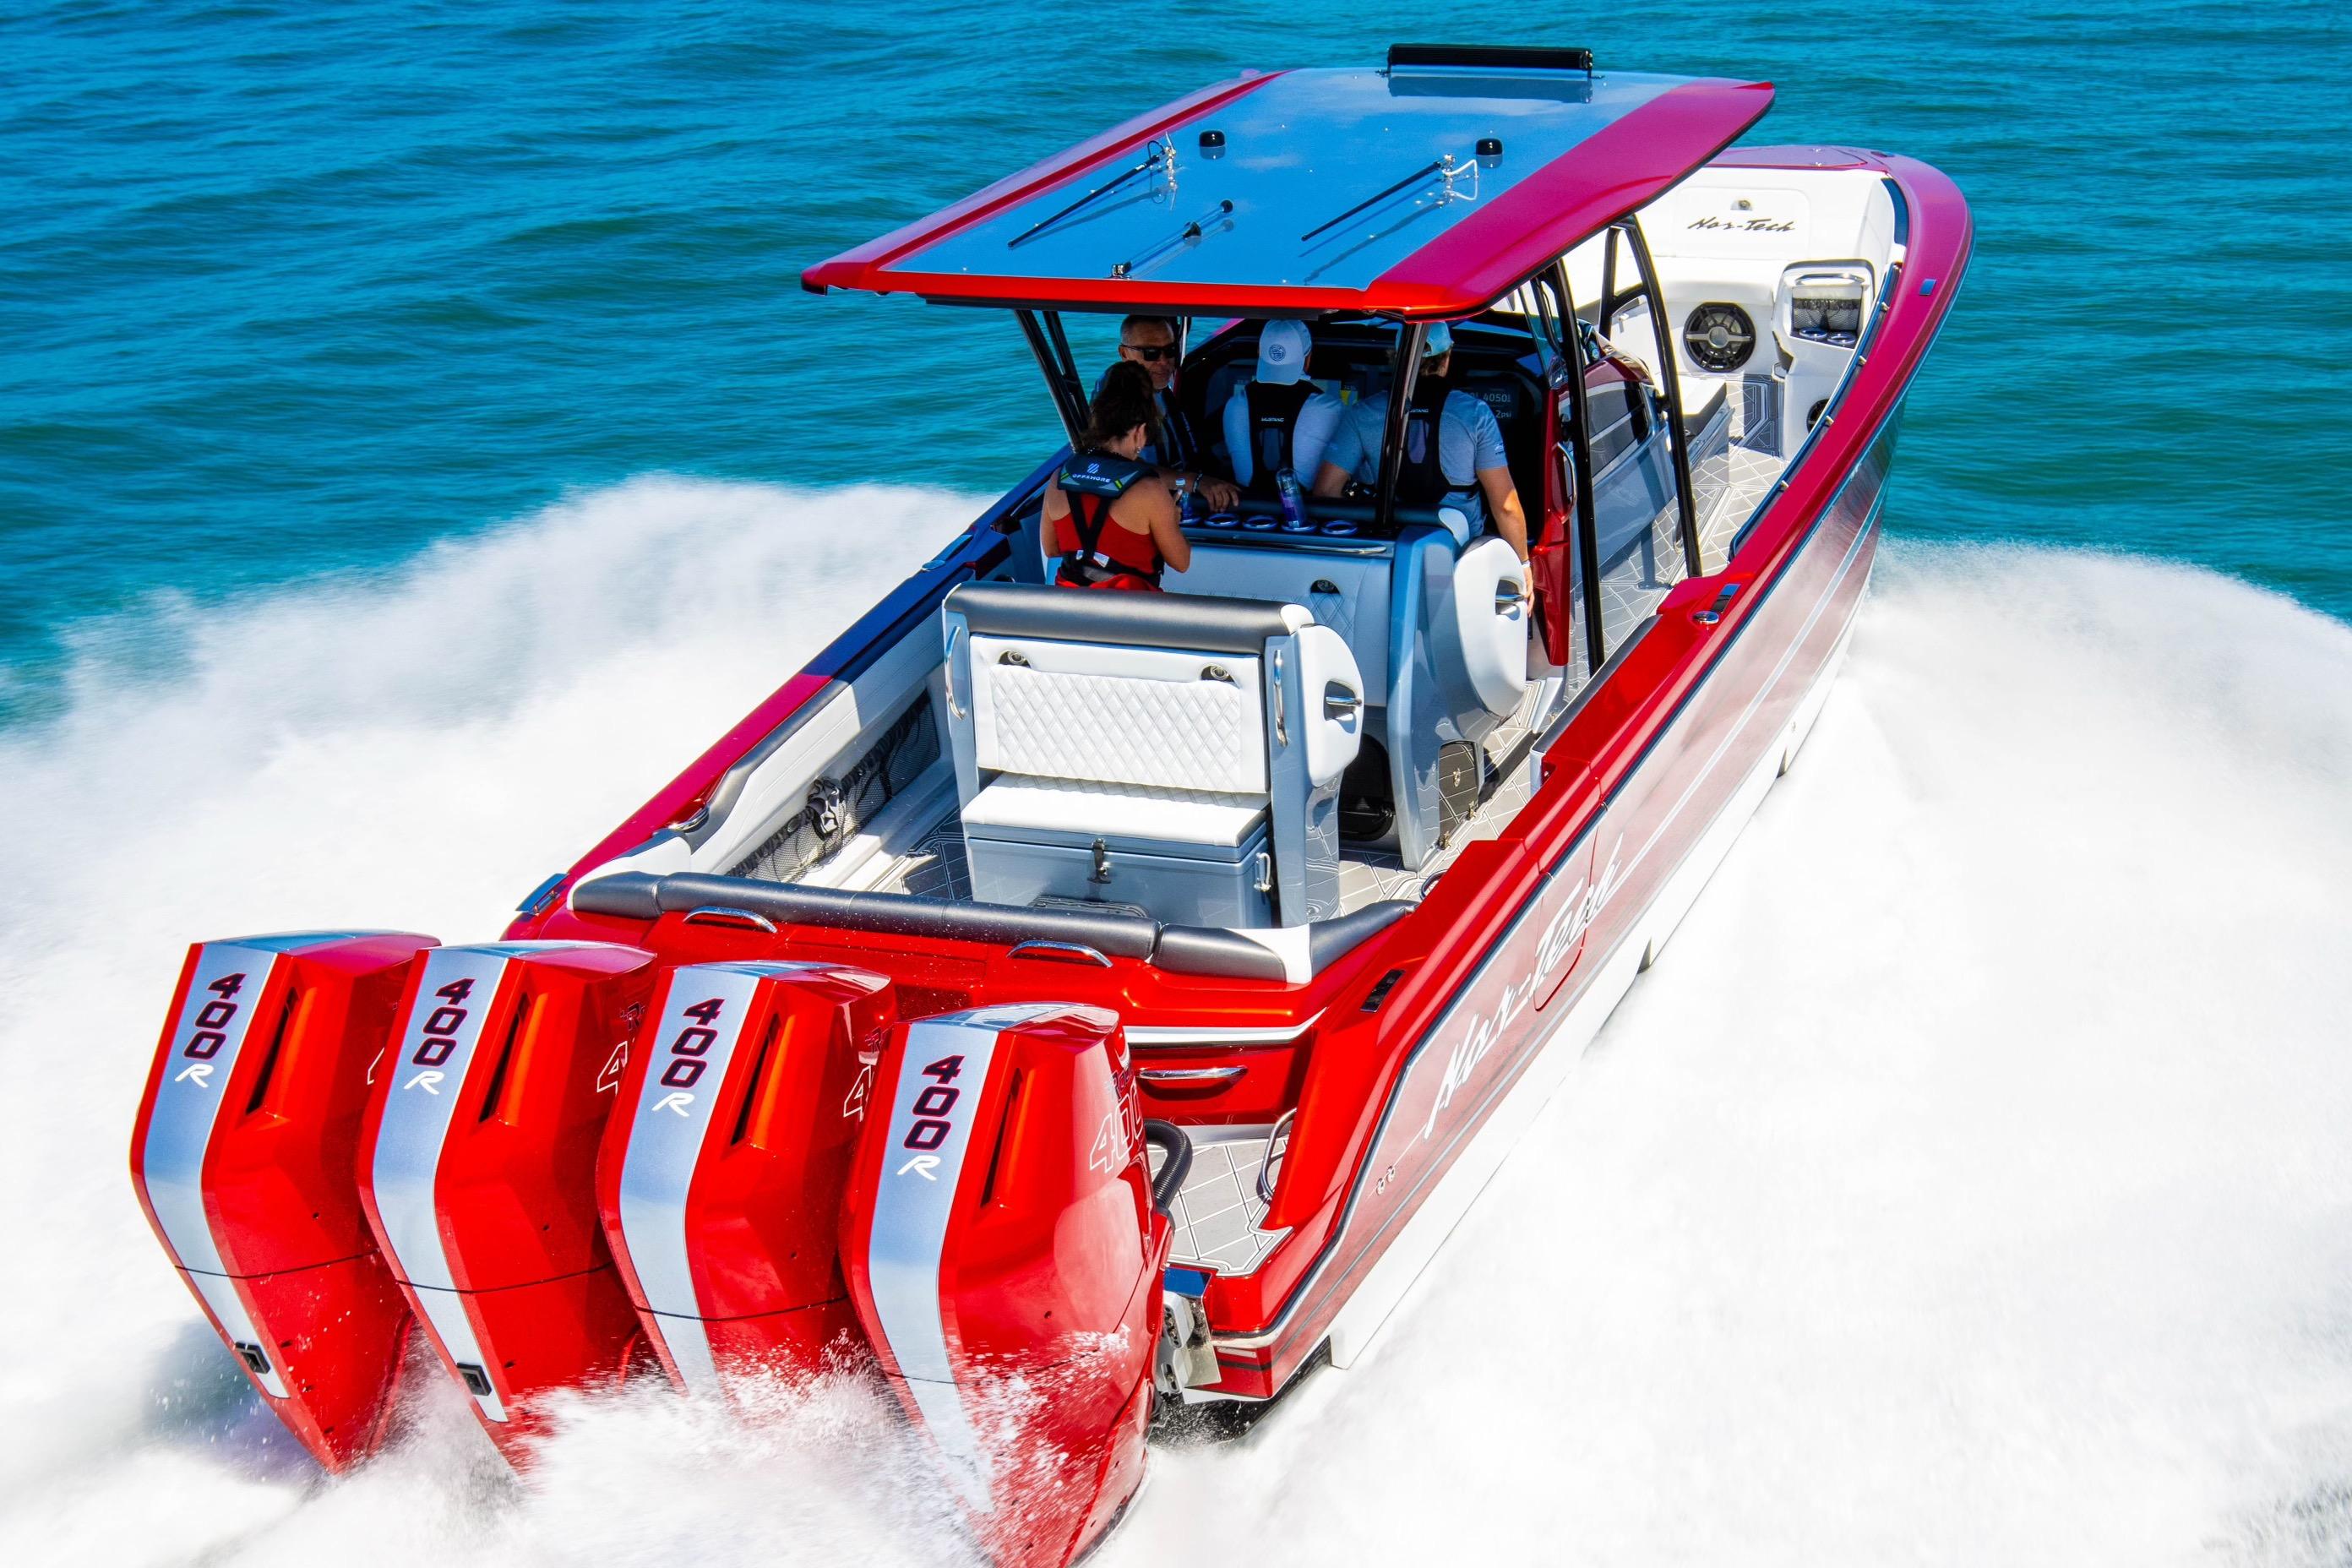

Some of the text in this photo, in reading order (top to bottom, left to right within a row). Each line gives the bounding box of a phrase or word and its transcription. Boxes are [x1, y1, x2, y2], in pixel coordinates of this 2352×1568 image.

[1687, 216, 1795, 231] Nor-Tech
[1072, 473, 1111, 483] OFFSHORE
[1424, 832, 1624, 1141] Nor-Tech
